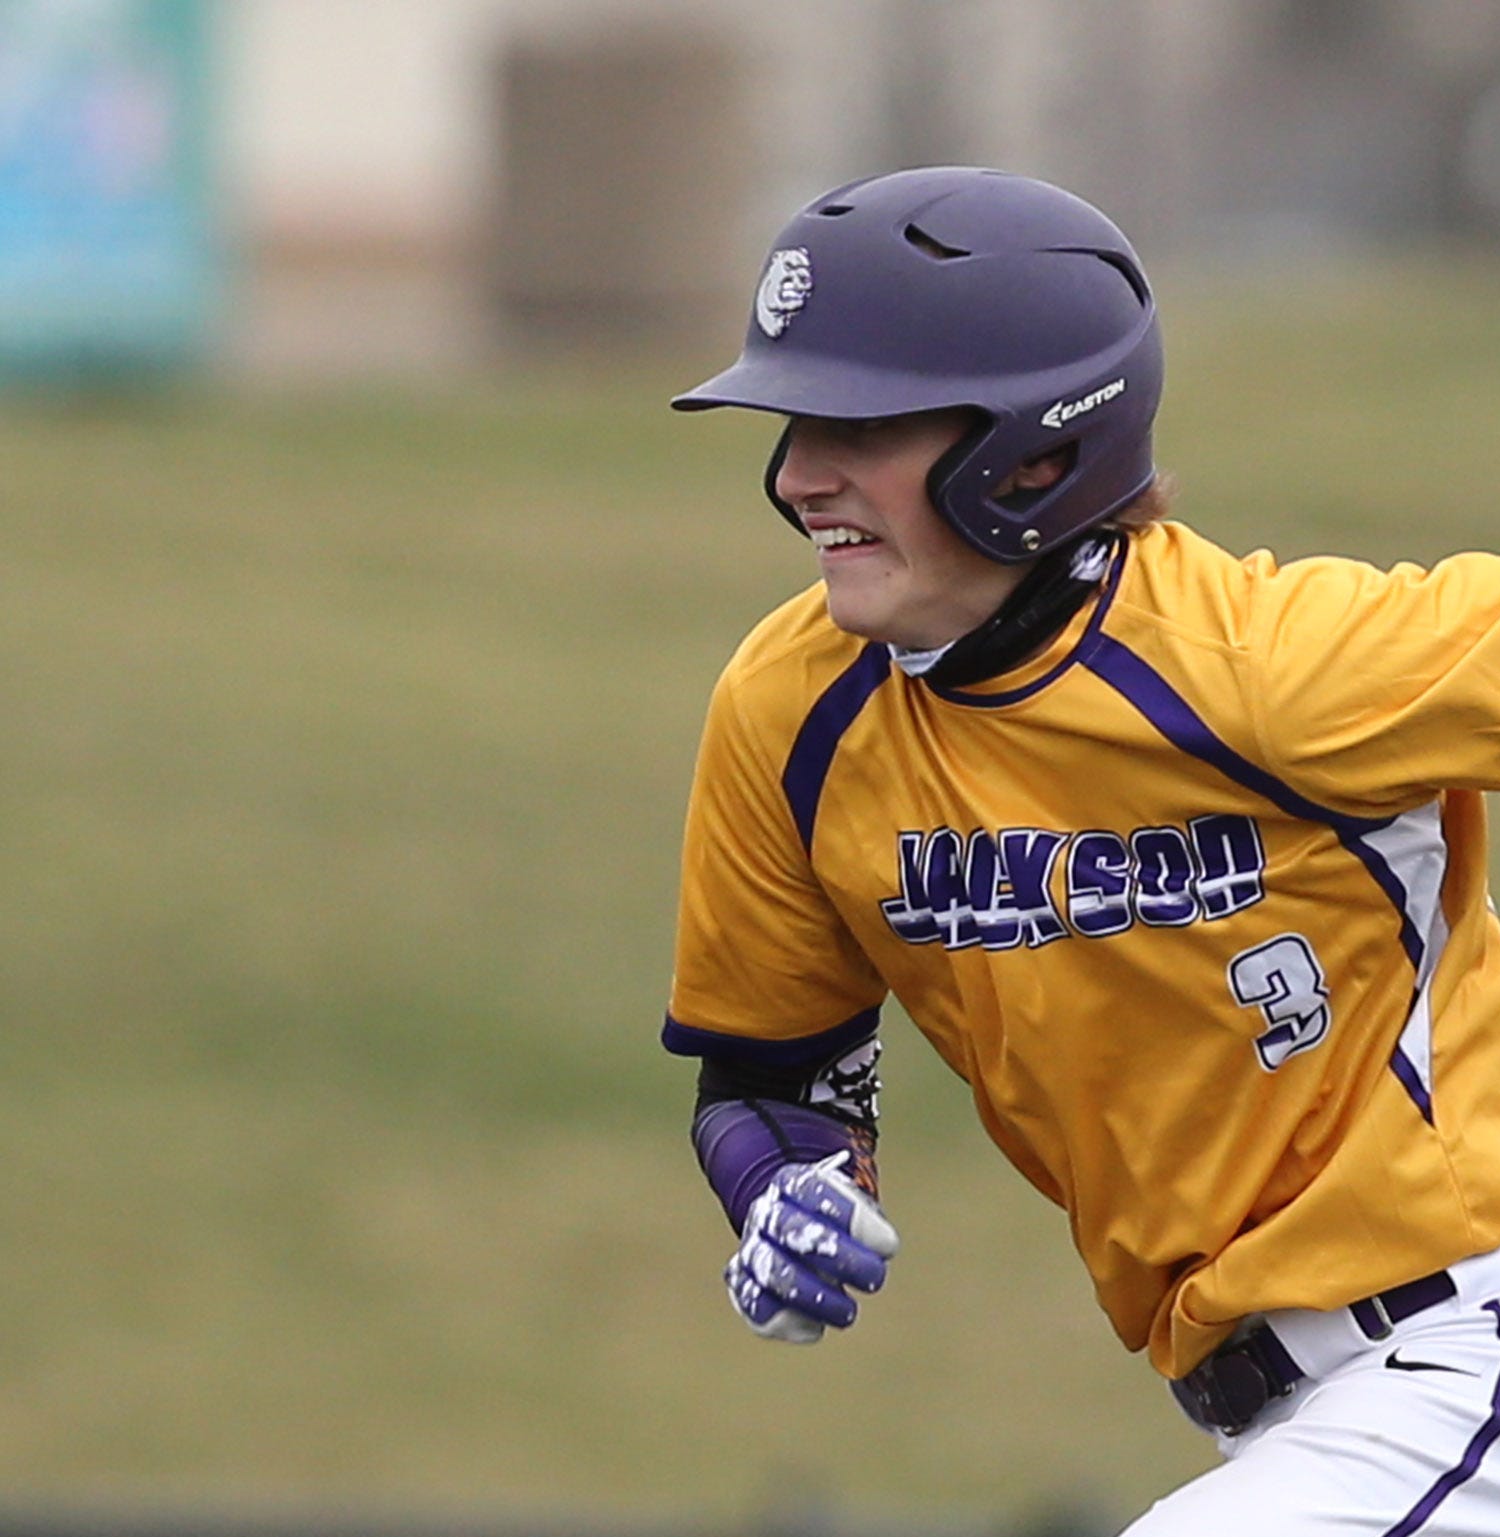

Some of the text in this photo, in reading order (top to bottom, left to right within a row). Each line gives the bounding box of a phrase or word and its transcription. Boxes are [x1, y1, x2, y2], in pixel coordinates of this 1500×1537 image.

[1060, 378, 1125, 421] EASTON
[879, 813, 1266, 951] JACKSON
[1226, 932, 1331, 1072] 3
